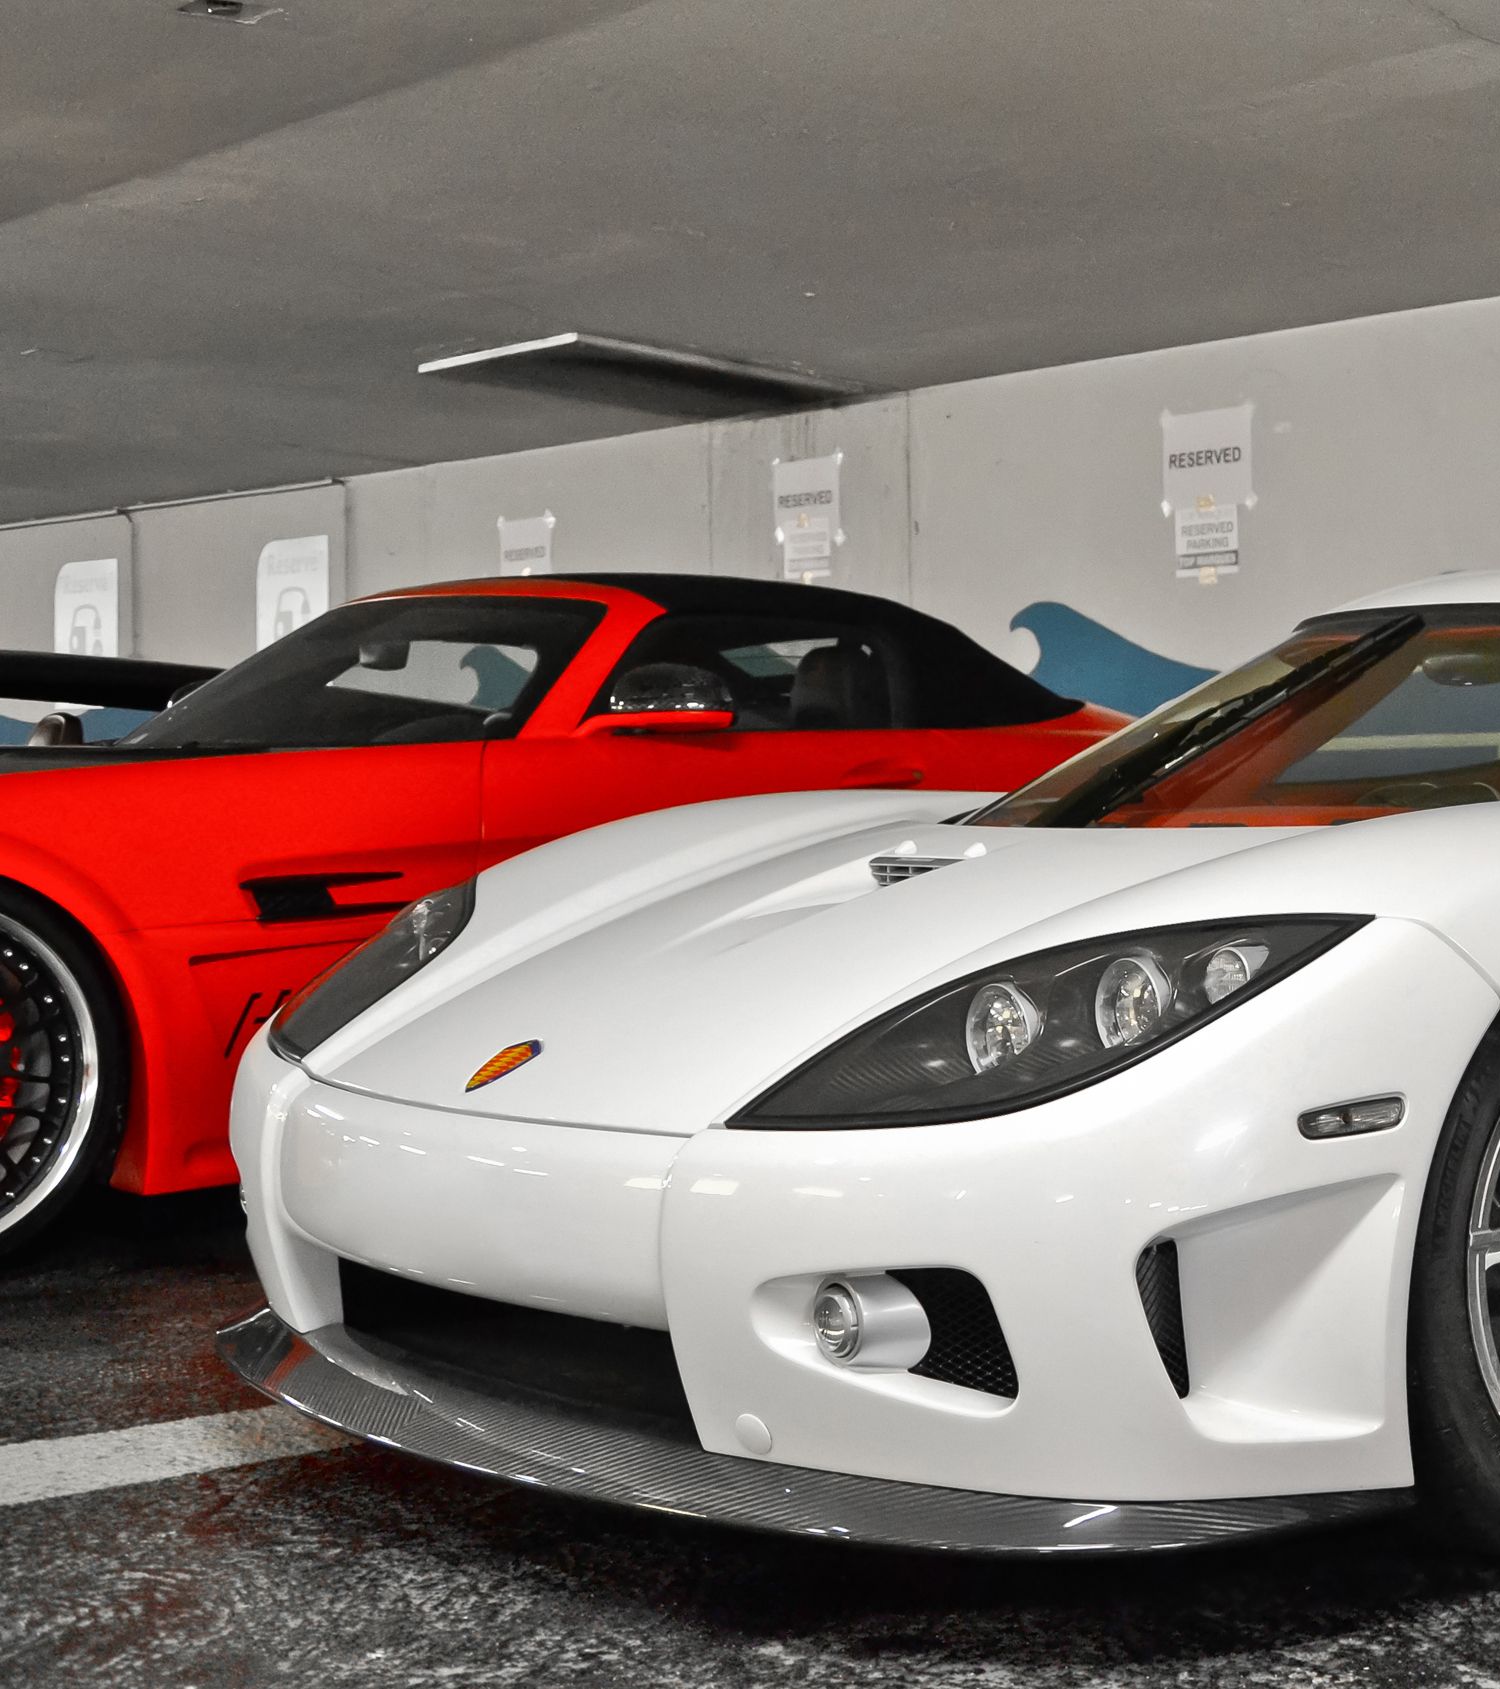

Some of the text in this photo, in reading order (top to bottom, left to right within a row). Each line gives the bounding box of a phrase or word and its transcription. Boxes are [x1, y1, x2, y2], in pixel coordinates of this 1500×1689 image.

[1169, 446, 1241, 469] RESERVED
[777, 489, 833, 509] RESERVED
[1181, 521, 1234, 537] RESERVED
[1186, 536, 1229, 551] PARKING
